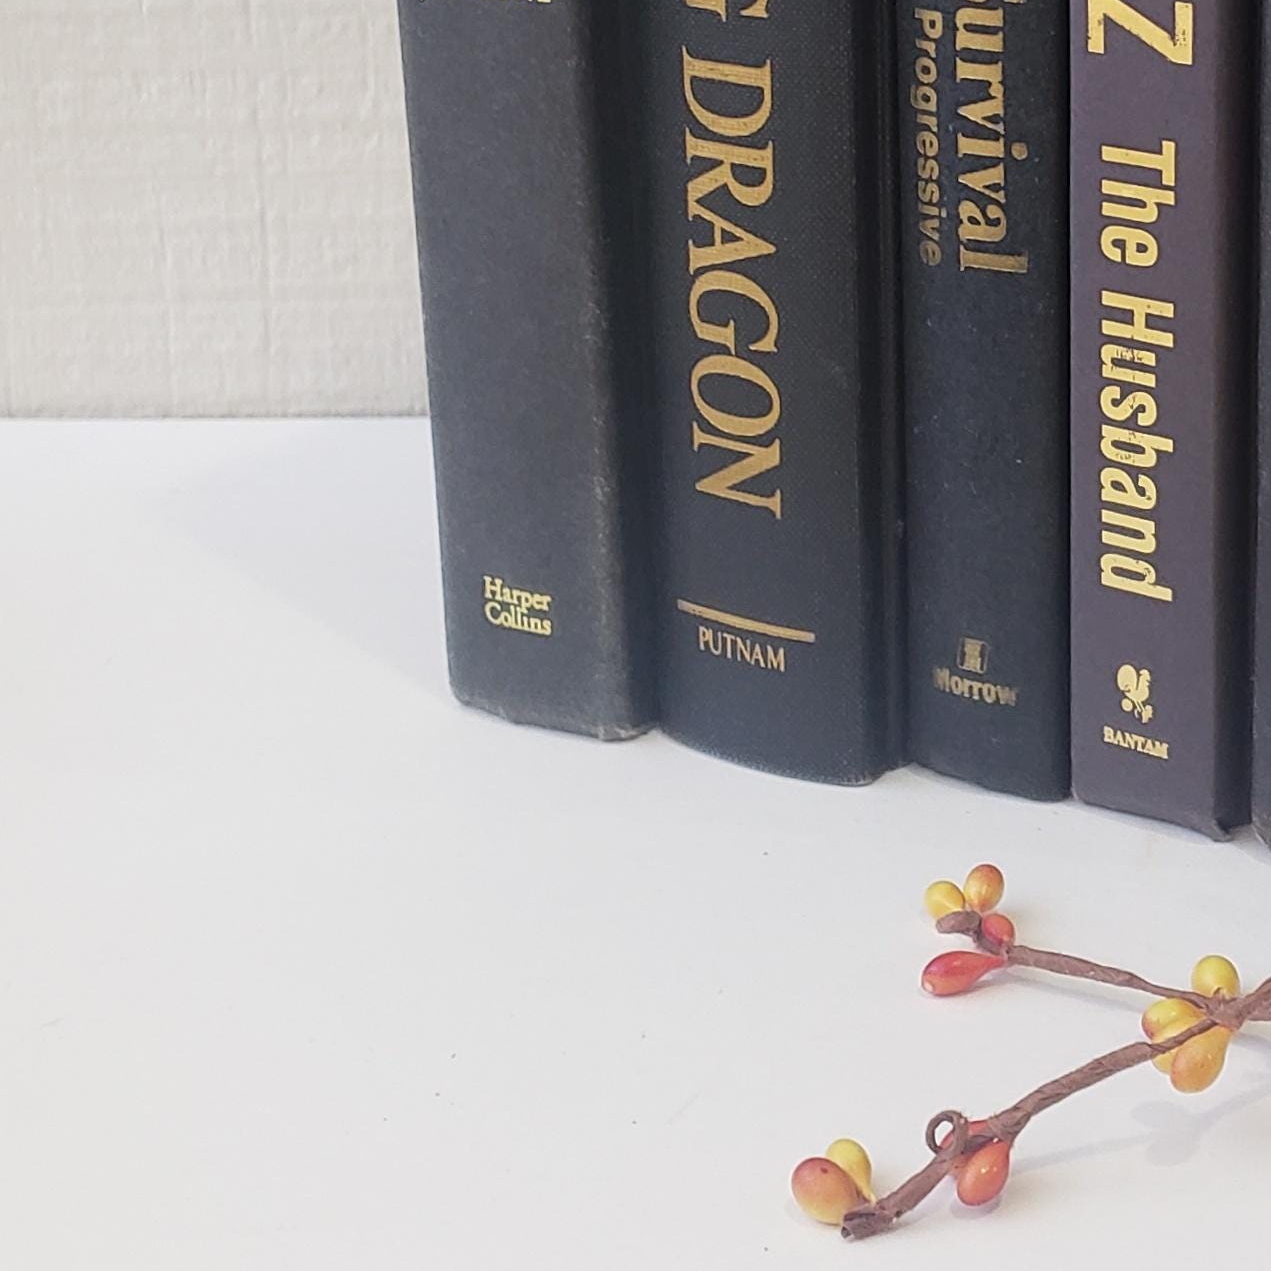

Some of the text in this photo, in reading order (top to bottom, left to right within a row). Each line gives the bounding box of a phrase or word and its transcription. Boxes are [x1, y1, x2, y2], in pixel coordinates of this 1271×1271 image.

[910, 8, 949, 267] Progressive
[680, 45, 782, 520] DRAGON
[1099, 139, 1176, 602] The Husband
[482, 575, 552, 612] Harper
[484, 601, 552, 637] Collins
[697, 625, 785, 673] PUTNAM
[932, 667, 1018, 708] Morrow
[1102, 725, 1169, 760] BANTAM
